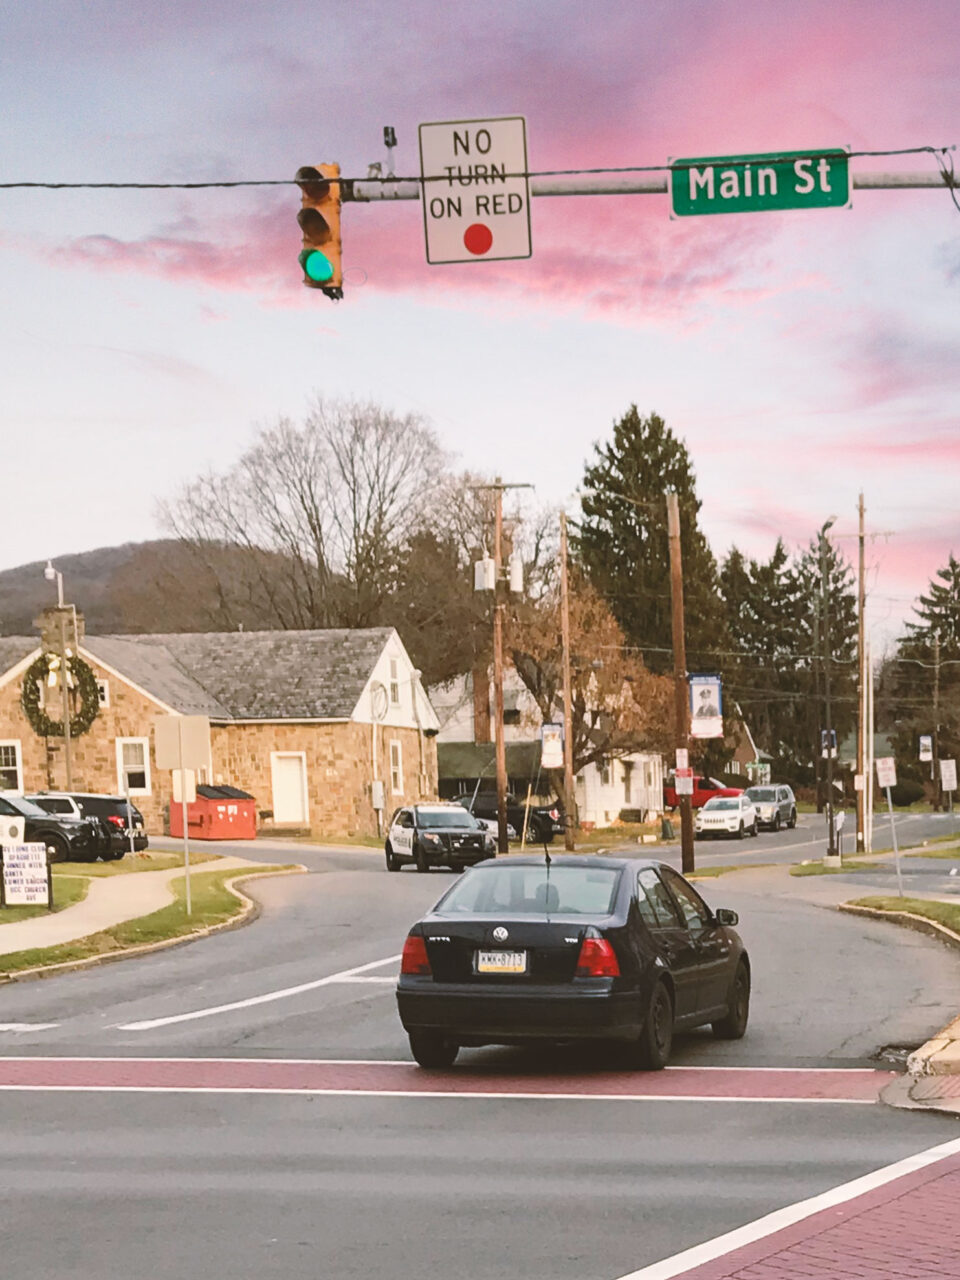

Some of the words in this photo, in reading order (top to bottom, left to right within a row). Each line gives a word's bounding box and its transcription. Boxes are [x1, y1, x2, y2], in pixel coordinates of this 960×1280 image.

[453, 129, 491, 156] NO
[444, 163, 506, 187] TURN
[688, 163, 778, 200] Main
[794, 157, 832, 194] St
[430, 196, 462, 219] ON
[476, 193, 523, 216] RED
